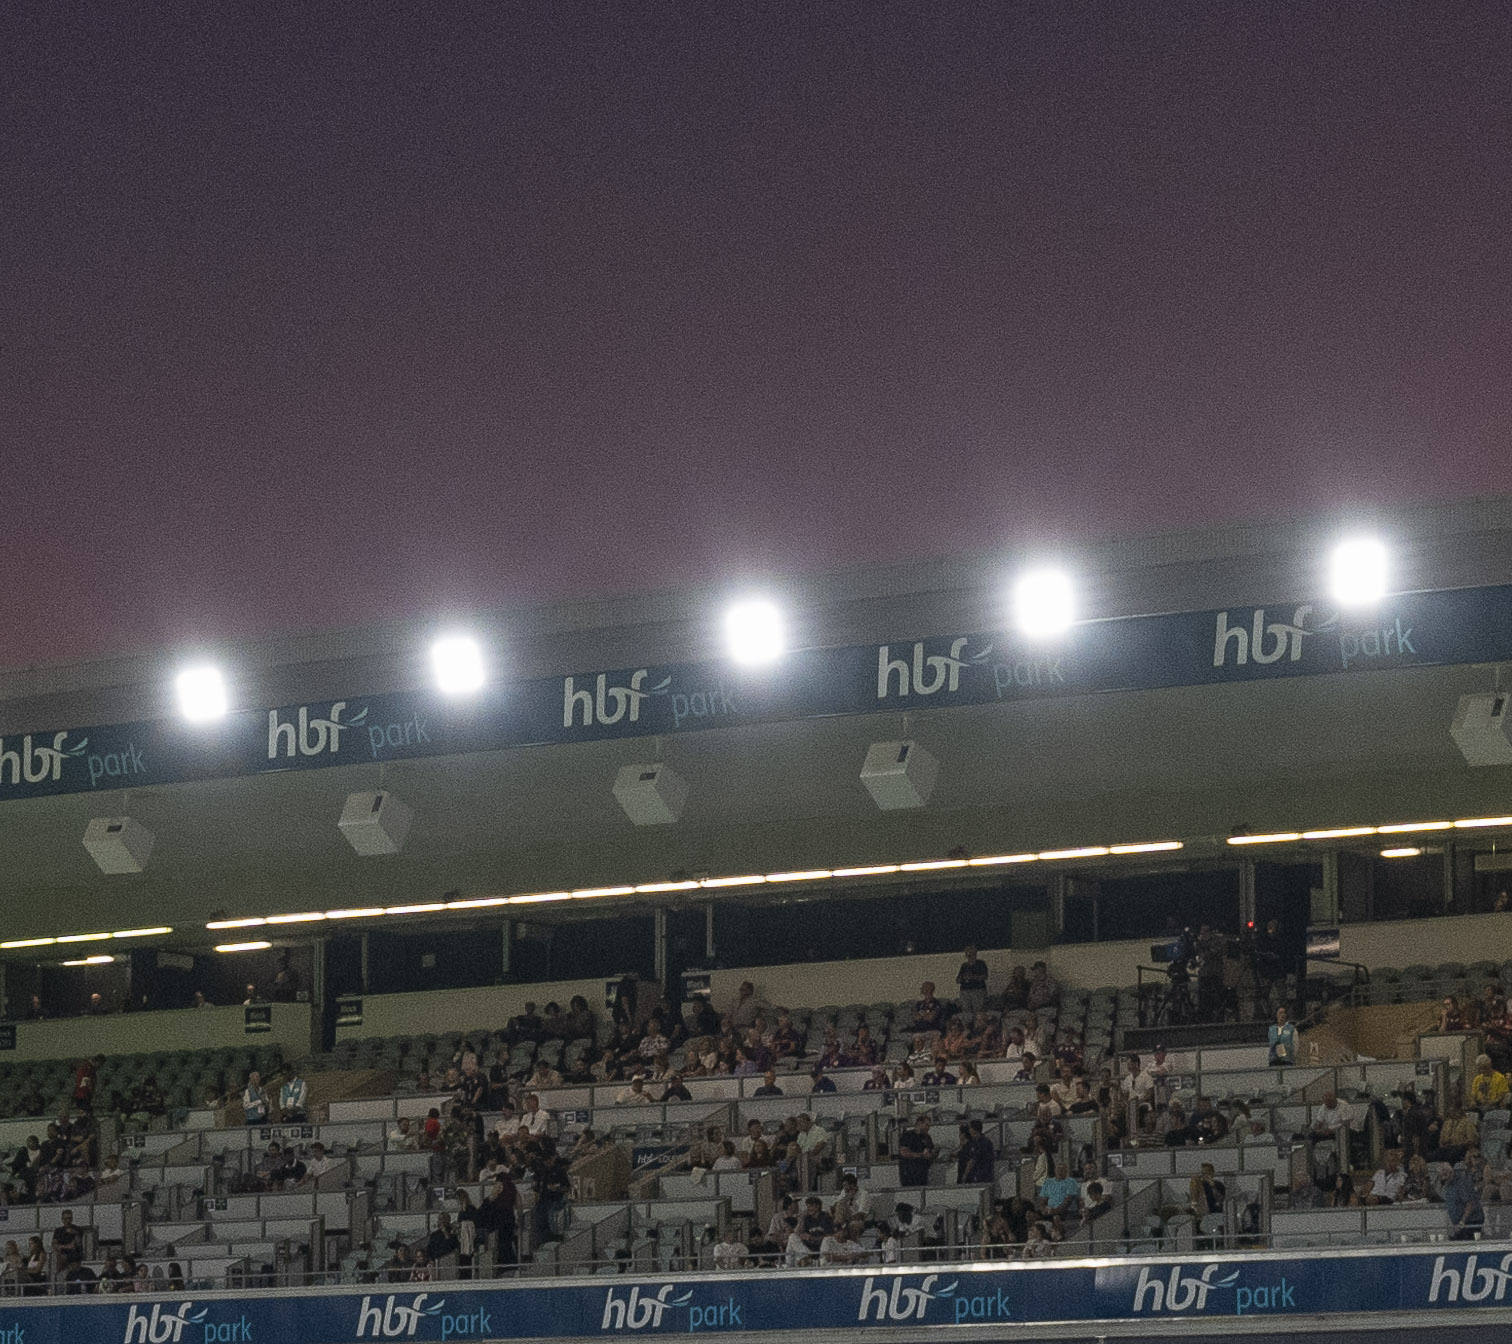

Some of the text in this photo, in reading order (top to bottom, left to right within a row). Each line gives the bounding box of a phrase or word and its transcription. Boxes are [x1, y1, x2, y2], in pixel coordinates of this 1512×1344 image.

[1214, 605, 1415, 668] hbf park
[877, 637, 1064, 699] hbf park
[563, 669, 737, 729] hbf park
[268, 701, 431, 760] hbf park
[88, 742, 147, 787] park
[601, 1285, 743, 1333] hbf park
[859, 1275, 1011, 1324] hbf park
[1135, 1264, 1295, 1315] hbf park
[124, 1303, 193, 1344] hbf
[356, 1295, 492, 1341] hbf park
